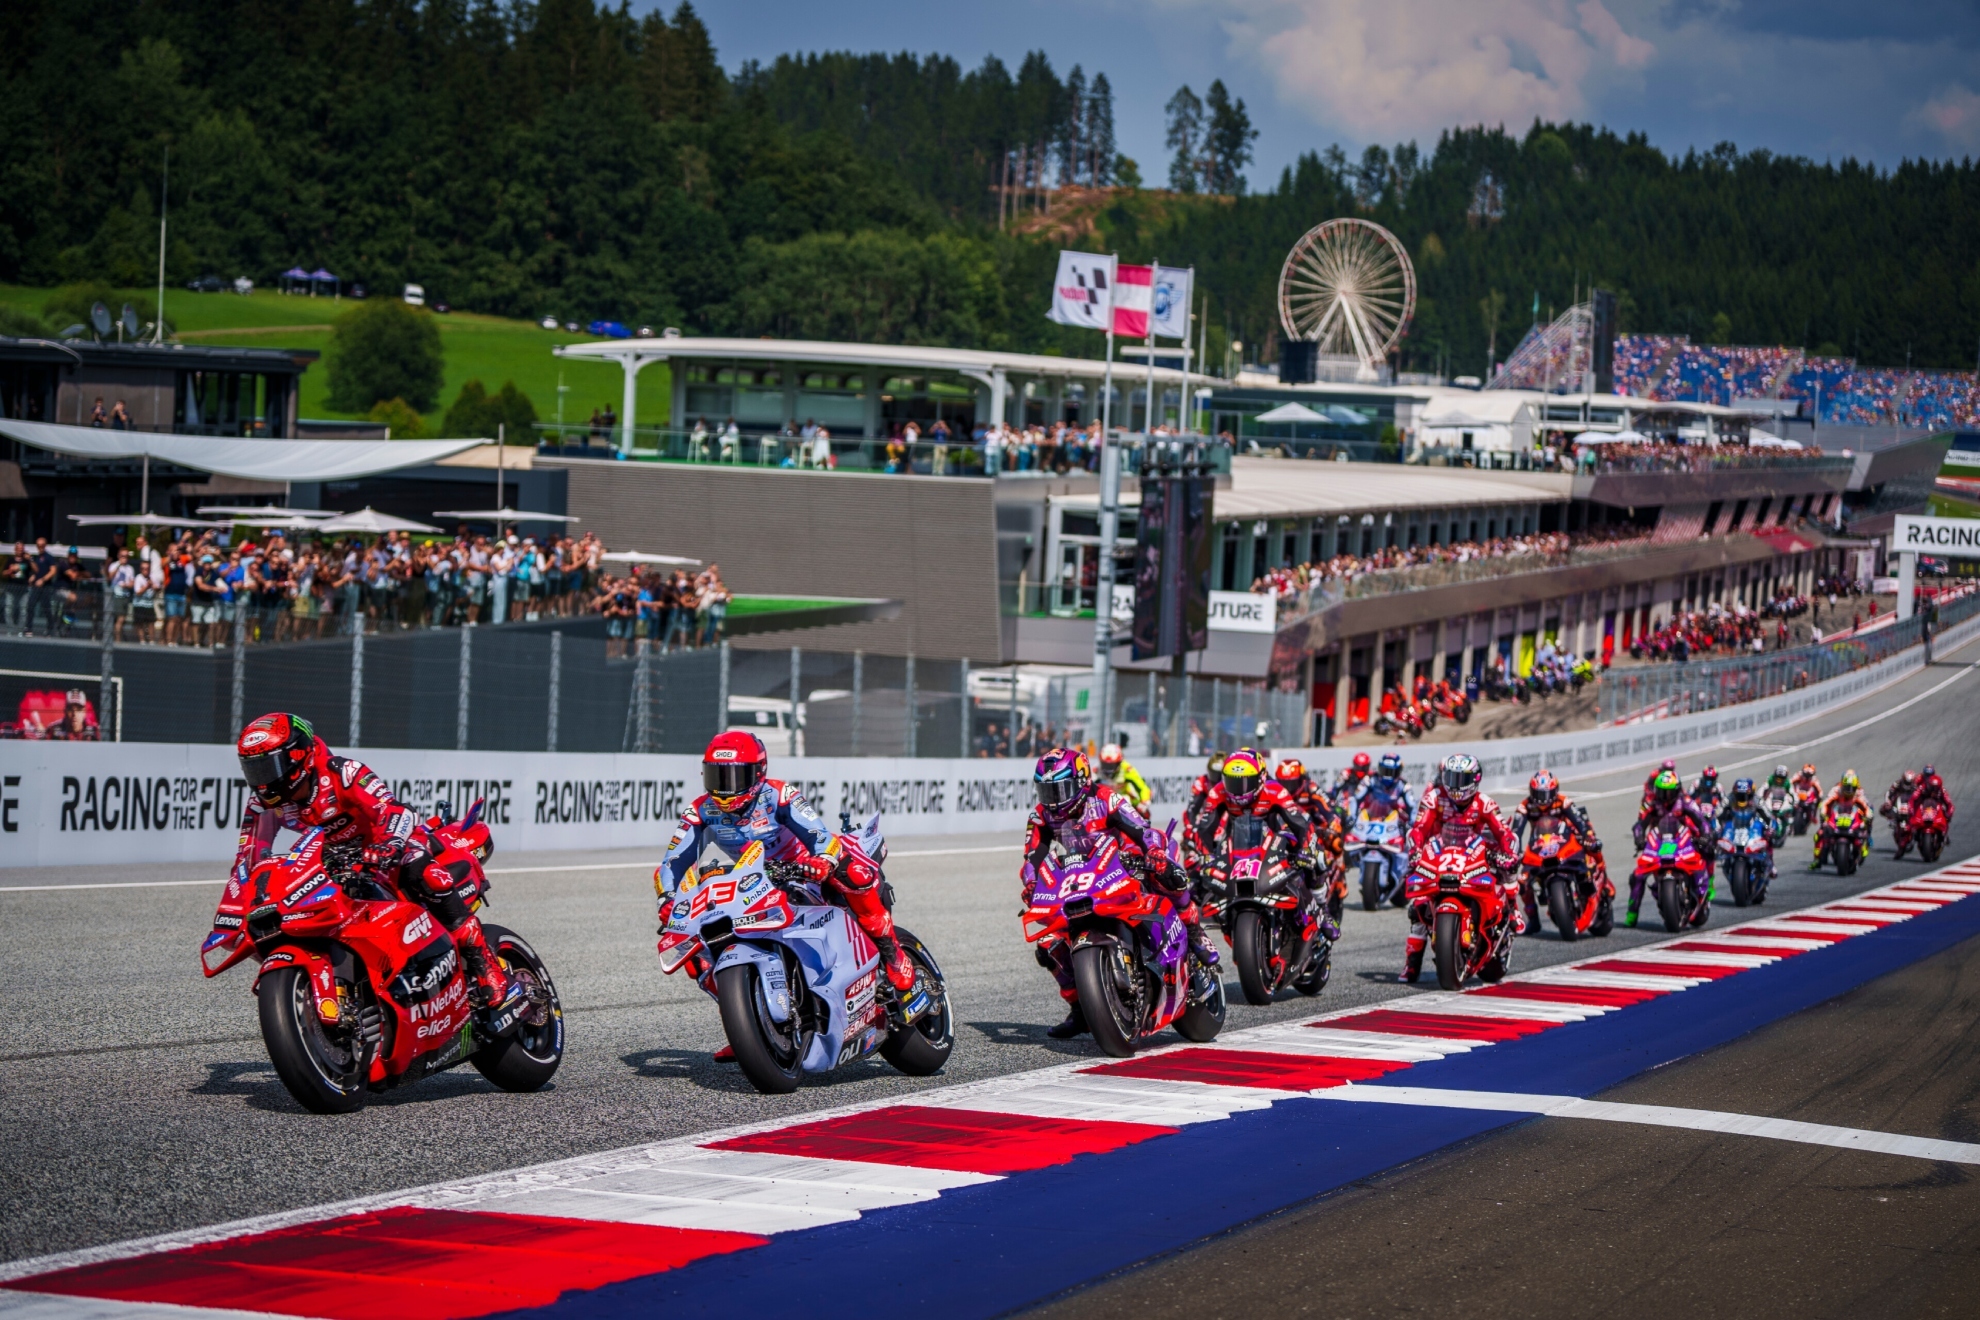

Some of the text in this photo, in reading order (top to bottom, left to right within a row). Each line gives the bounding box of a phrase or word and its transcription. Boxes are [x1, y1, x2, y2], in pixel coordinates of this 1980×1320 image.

[1208, 602, 1263, 620] UTURE
[173, 777, 197, 802] FOR
[840, 780, 888, 815] RACING
[900, 780, 945, 813] FUTURE
[60, 775, 170, 831] RACING
[198, 777, 248, 830] FUT
[413, 780, 432, 800] FOR
[435, 780, 512, 824] FUTURE
[535, 780, 684, 824] RACING FOR THE FUTURE
[172, 806, 196, 830] THE
[323, 817, 347, 834] ovo
[1835, 817, 1852, 827] 36
[297, 841, 322, 866] riello
[1064, 854, 1083, 866] FIAMM
[1097, 846, 1117, 871] PRAMAC
[1437, 853, 1467, 872] 23
[1064, 861, 1084, 874] prima
[1095, 868, 1123, 889] prima
[1230, 858, 1262, 880] 41
[1415, 865, 1436, 880] Lenovo
[1462, 865, 1487, 880] Lenovo
[282, 873, 326, 907] Lenovo
[457, 884, 476, 898] novo
[1032, 892, 1056, 903] prima
[1058, 872, 1096, 899] 89
[316, 894, 332, 902] TIM
[689, 880, 738, 920] 93
[214, 914, 243, 927] Lenovo
[402, 911, 433, 945] GIVI
[733, 915, 756, 925] BOLD
[809, 909, 835, 930] DUCATI
[263, 953, 293, 965] novo
[399, 949, 457, 995] Lenovo
[430, 978, 463, 1018] NetApp
[417, 1014, 451, 1039] elica
[425, 1041, 462, 1070] MONSTER
[838, 1037, 862, 1065] OLI
